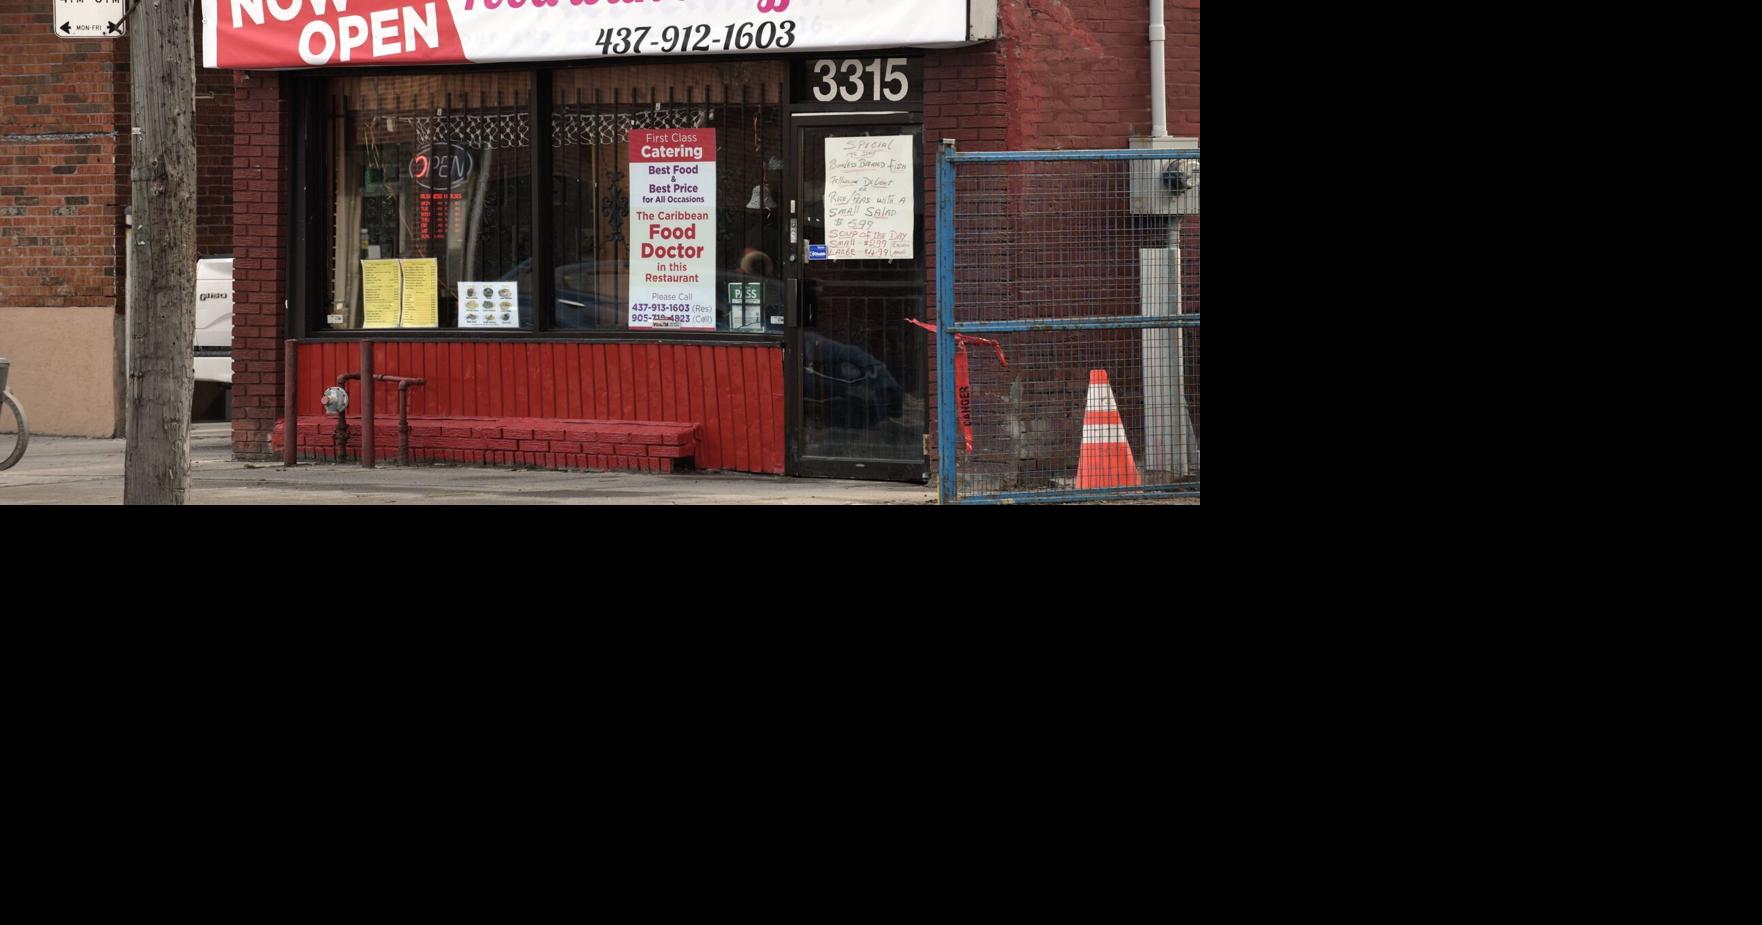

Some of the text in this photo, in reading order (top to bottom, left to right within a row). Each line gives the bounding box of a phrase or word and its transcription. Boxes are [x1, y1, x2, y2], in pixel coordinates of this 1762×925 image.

[298, 2, 439, 65] OPEN
[596, 19, 795, 55] 437-912-1603
[812, 58, 909, 102] 3315
[646, 132, 697, 143] First Class
[640, 145, 703, 160] Catering
[415, 155, 465, 178] OPEN
[648, 164, 698, 175] Best Food
[649, 184, 698, 193] Best Price
[642, 195, 705, 203] for All Occasions
[636, 211, 709, 221] The Caribbean
[649, 223, 696, 240] Food
[641, 243, 704, 259] Doctor
[657, 263, 687, 271] in this
[645, 274, 699, 283] Restaurant
[652, 292, 692, 301] Please Call
[735, 288, 757, 299] PASS
[632, 304, 713, 314] 437-913-1603 (Res)
[959, 386, 972, 427] DANGER
